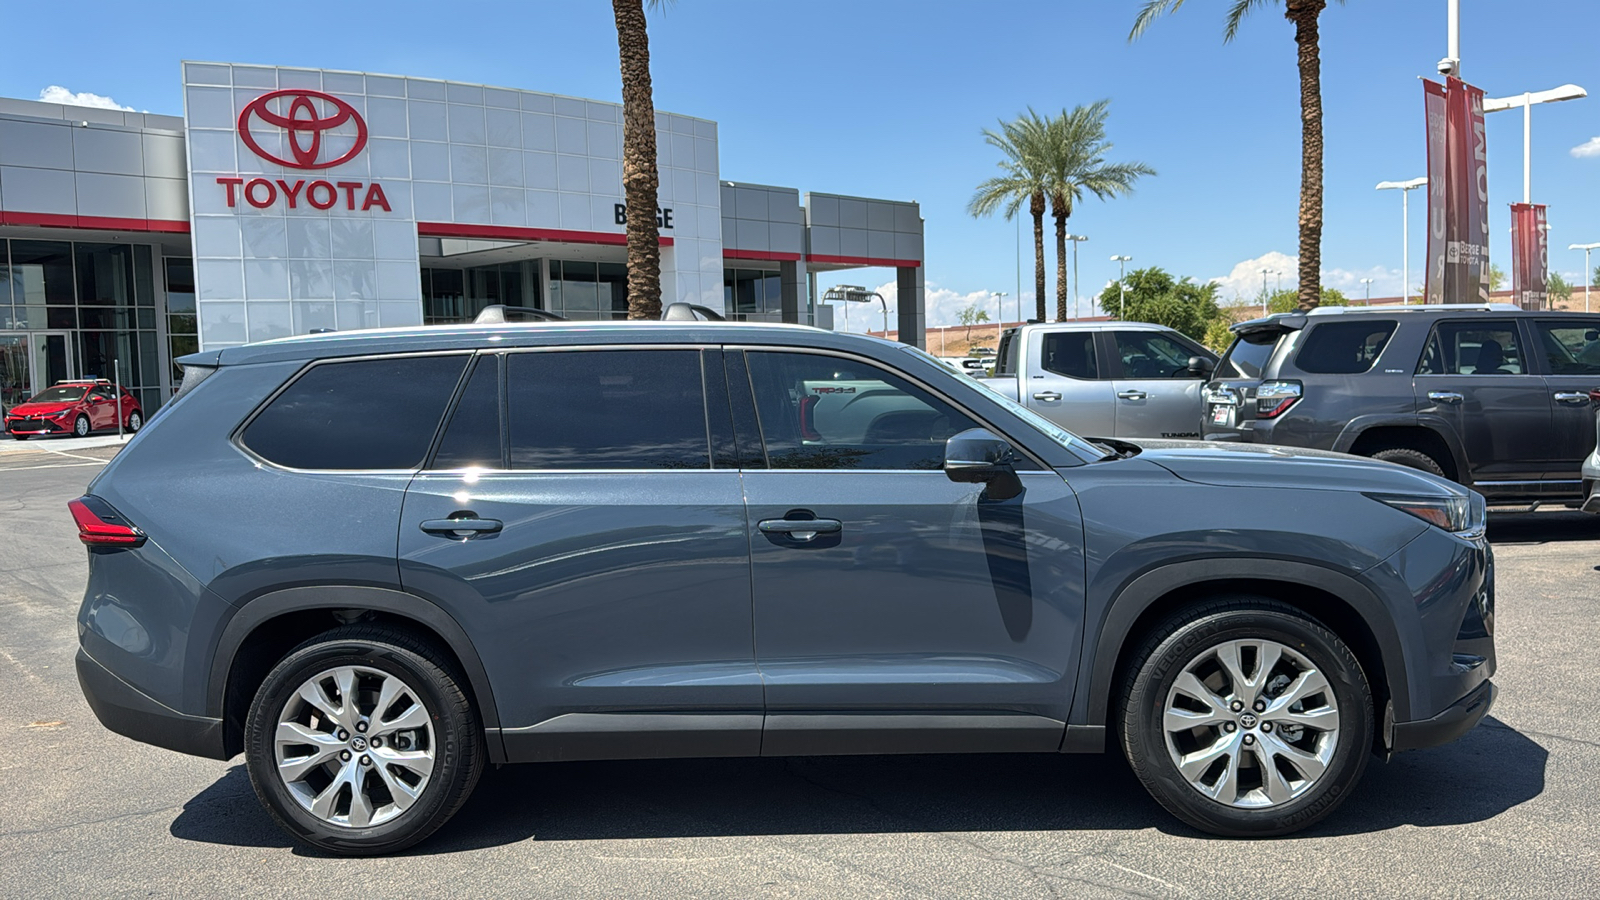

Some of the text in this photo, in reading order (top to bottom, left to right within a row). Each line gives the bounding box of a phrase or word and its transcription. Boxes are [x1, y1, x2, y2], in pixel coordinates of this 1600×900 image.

[216, 177, 392, 212] TOYOTA
[614, 203, 674, 229] BGE
[1471, 92, 1489, 302] ECOME
[1460, 241, 1480, 256] BERGE
[1536, 207, 1547, 311] ECOME
[1152, 620, 1220, 681] VELOCITY
[1274, 785, 1342, 830] OMNIMAX
